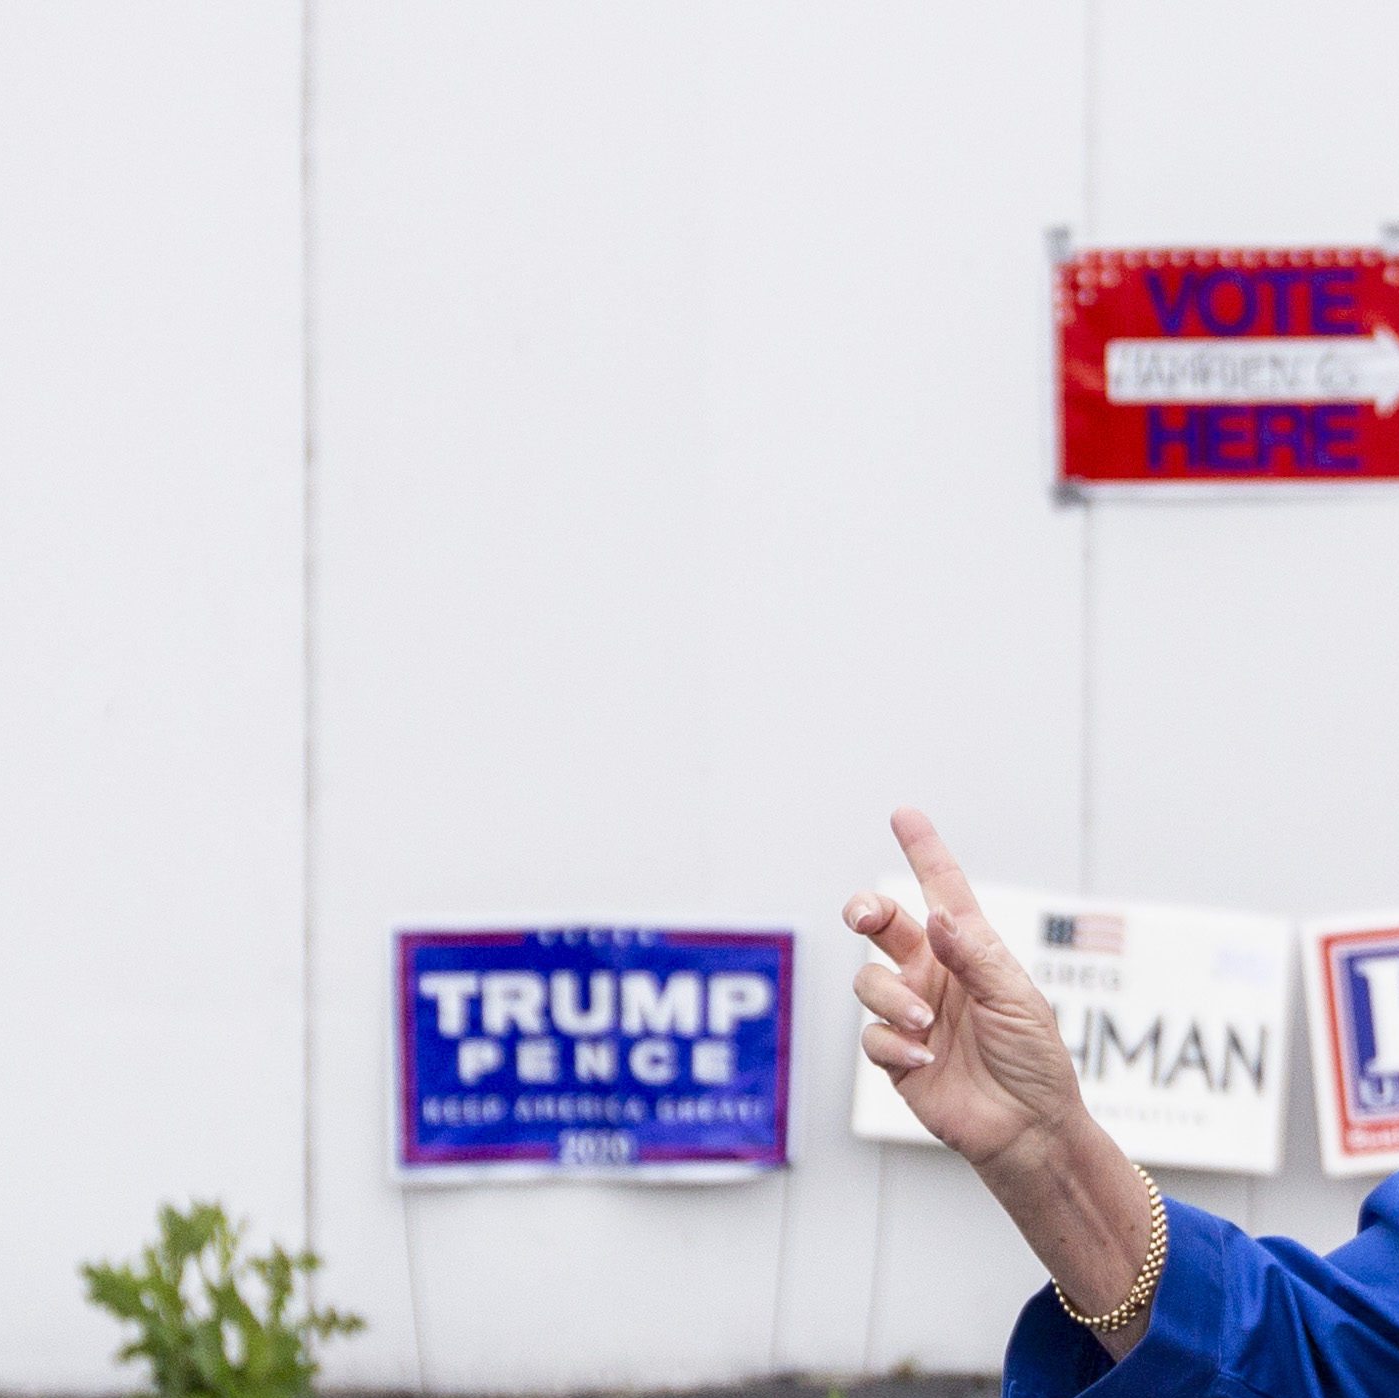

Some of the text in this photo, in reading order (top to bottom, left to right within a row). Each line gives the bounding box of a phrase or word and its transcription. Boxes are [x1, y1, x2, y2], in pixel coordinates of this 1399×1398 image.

[1145, 266, 1358, 336] VOTE
[1145, 404, 1361, 471] HERE
[419, 970, 770, 1038] TRUMP
[1033, 961, 1122, 992] GREG
[458, 1038, 733, 1085] PENCE
